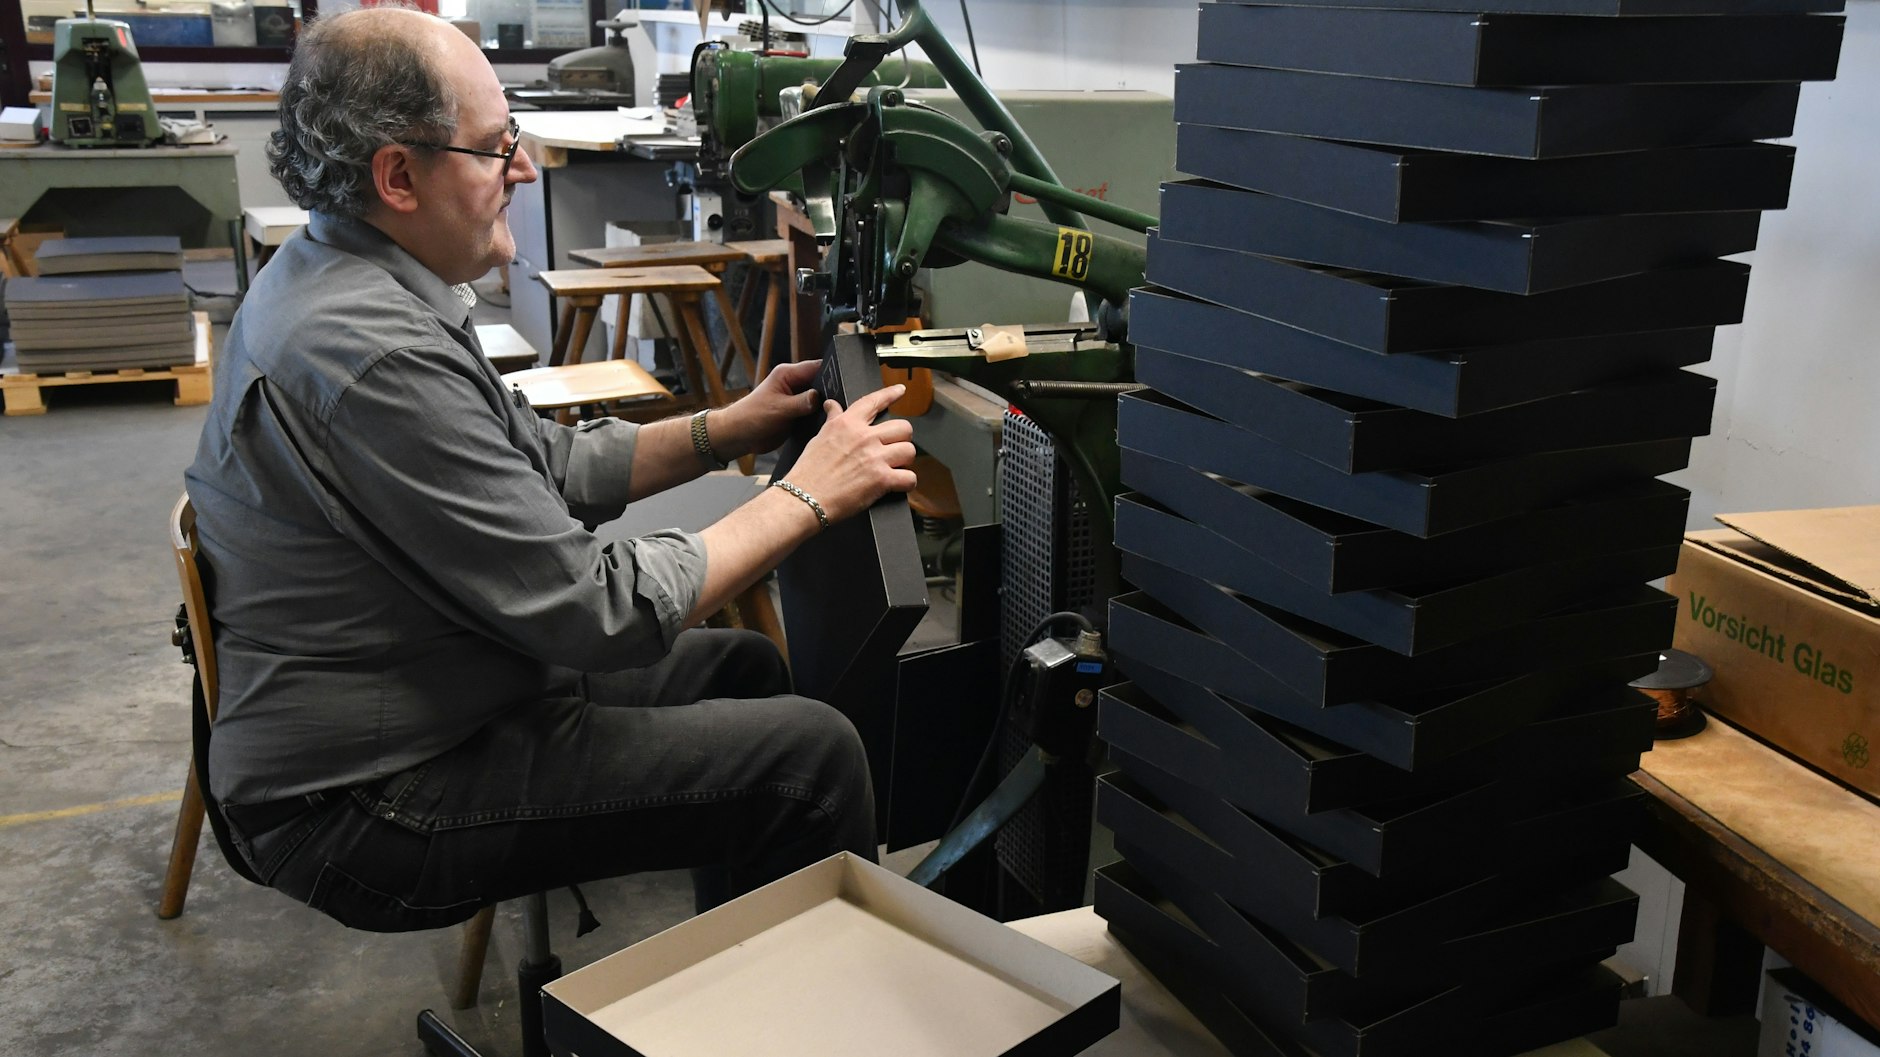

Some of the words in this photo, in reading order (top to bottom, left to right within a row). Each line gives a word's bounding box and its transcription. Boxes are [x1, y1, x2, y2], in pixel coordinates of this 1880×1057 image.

[1059, 231, 1091, 279] 18
[1689, 592, 1787, 663] Vorsicht
[1793, 643, 1854, 695] Glas
